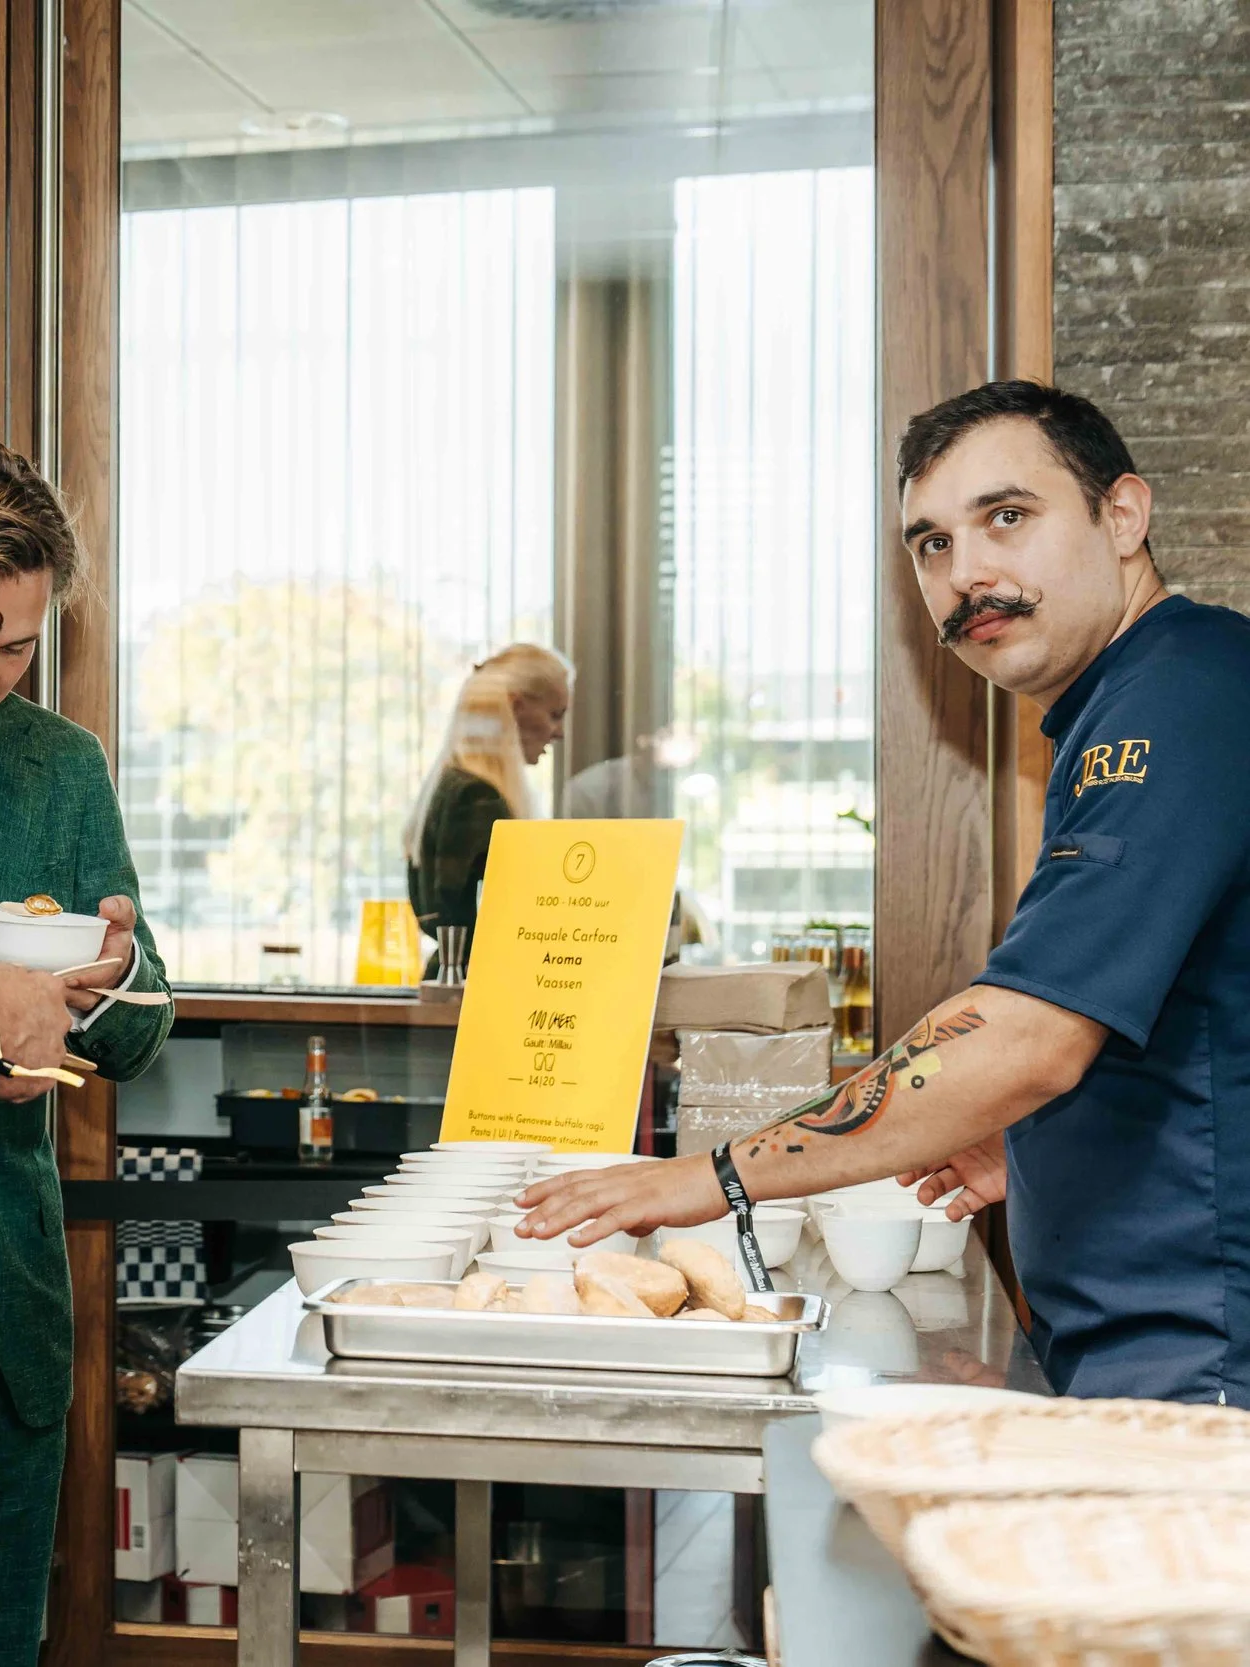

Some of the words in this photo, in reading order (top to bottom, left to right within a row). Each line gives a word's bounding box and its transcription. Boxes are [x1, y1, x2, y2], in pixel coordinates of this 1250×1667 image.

[575, 853, 585, 871] 7
[594, 900, 610, 908] uur
[517, 926, 568, 944] Pasquale
[572, 927, 618, 943] Carfora
[542, 951, 583, 966] Aroma
[536, 974, 583, 990] Vaassen
[497, 1112, 514, 1122] with
[515, 1113, 552, 1126] Genovese
[554, 1116, 584, 1129] buffalo
[470, 1125, 492, 1137] Pasta
[559, 1136, 599, 1146] structuren
